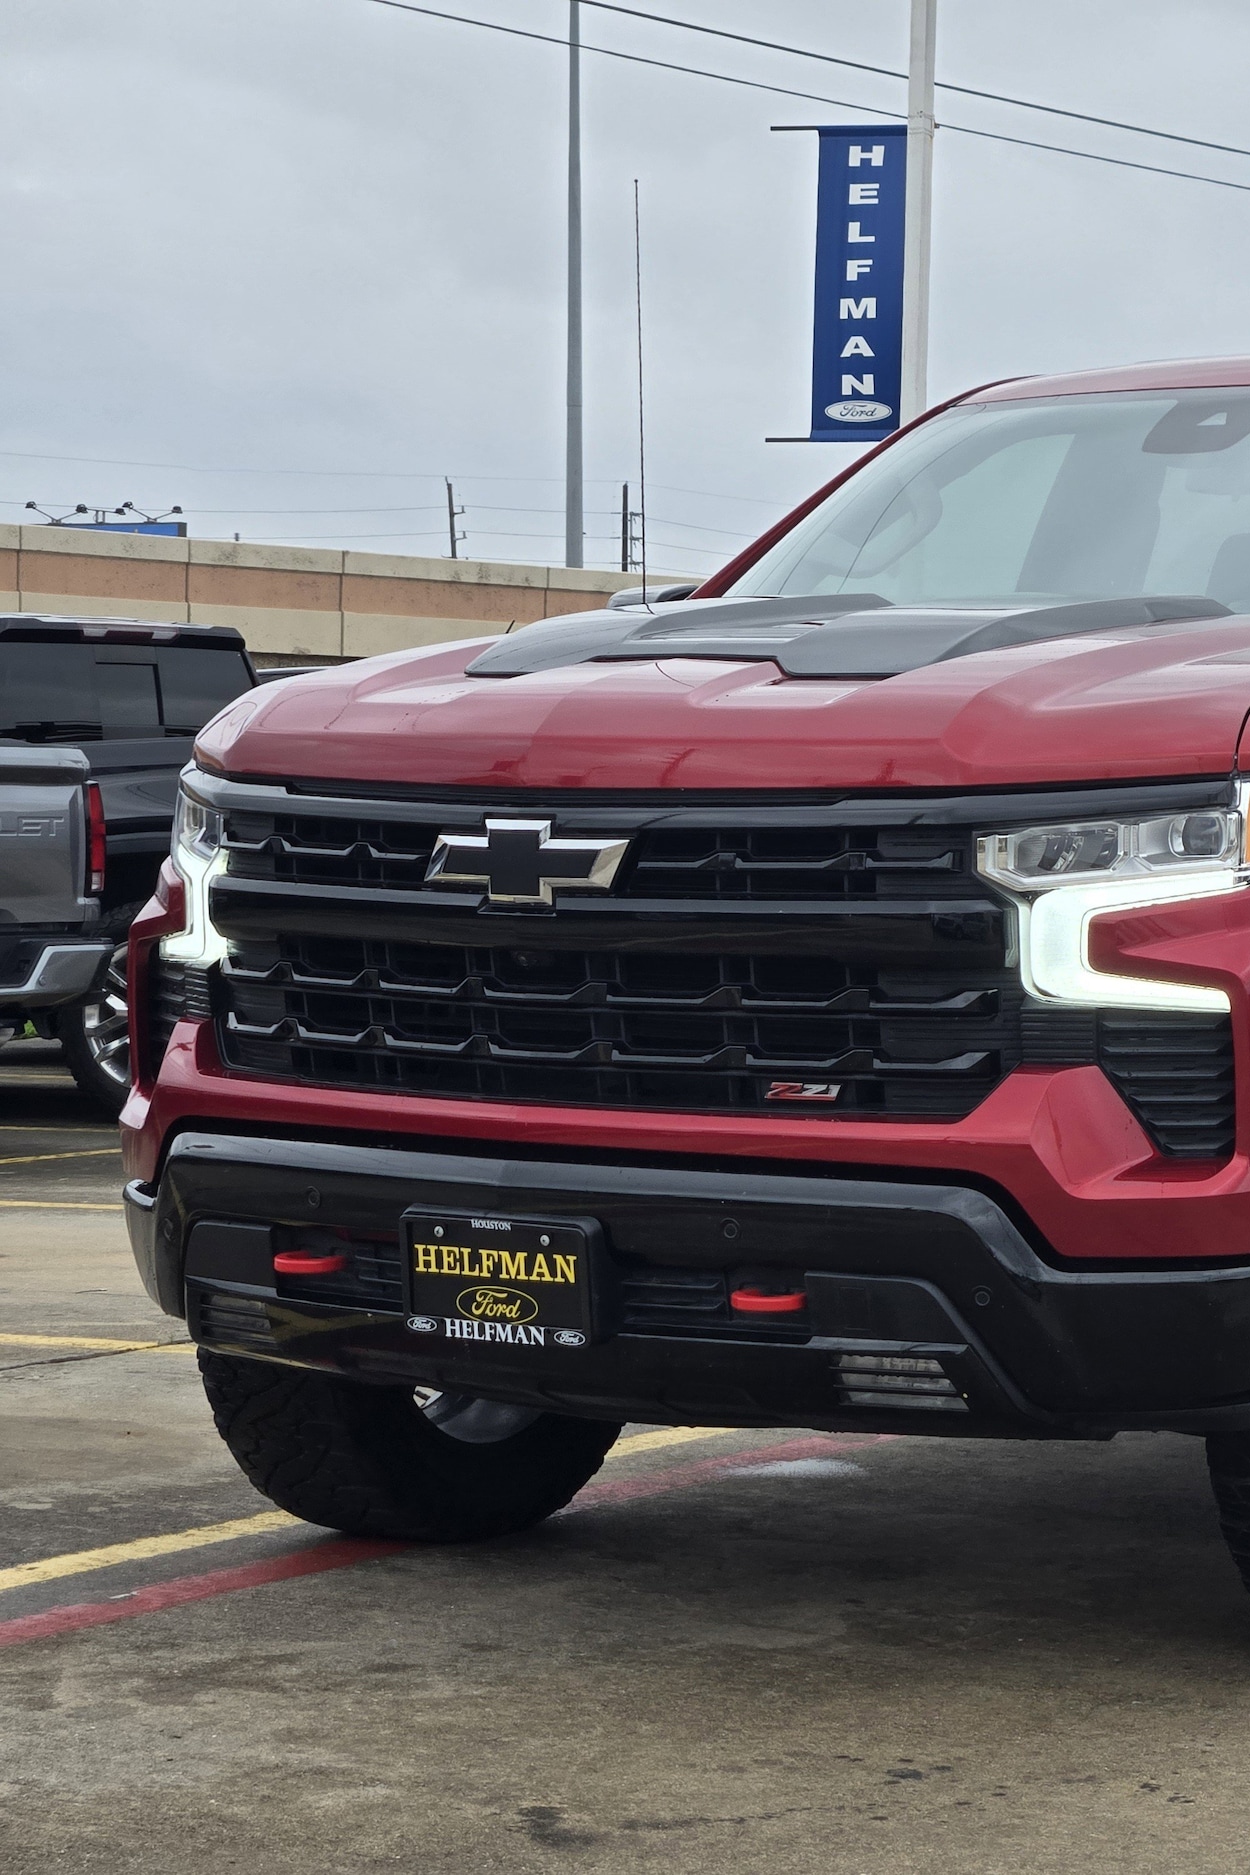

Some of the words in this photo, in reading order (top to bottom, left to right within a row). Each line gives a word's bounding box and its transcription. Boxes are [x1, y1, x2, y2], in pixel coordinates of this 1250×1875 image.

[839, 145, 885, 396] HELFMAN
[839, 404, 877, 419] Ford
[765, 1081, 842, 1101] Z71
[471, 1219, 512, 1231] HOUSTON
[414, 1244, 577, 1284] HELFMAN
[471, 1290, 521, 1319] Ford
[412, 1319, 432, 1330] Ford
[444, 1318, 546, 1346] HELFMAN
[559, 1333, 580, 1344] Ford
